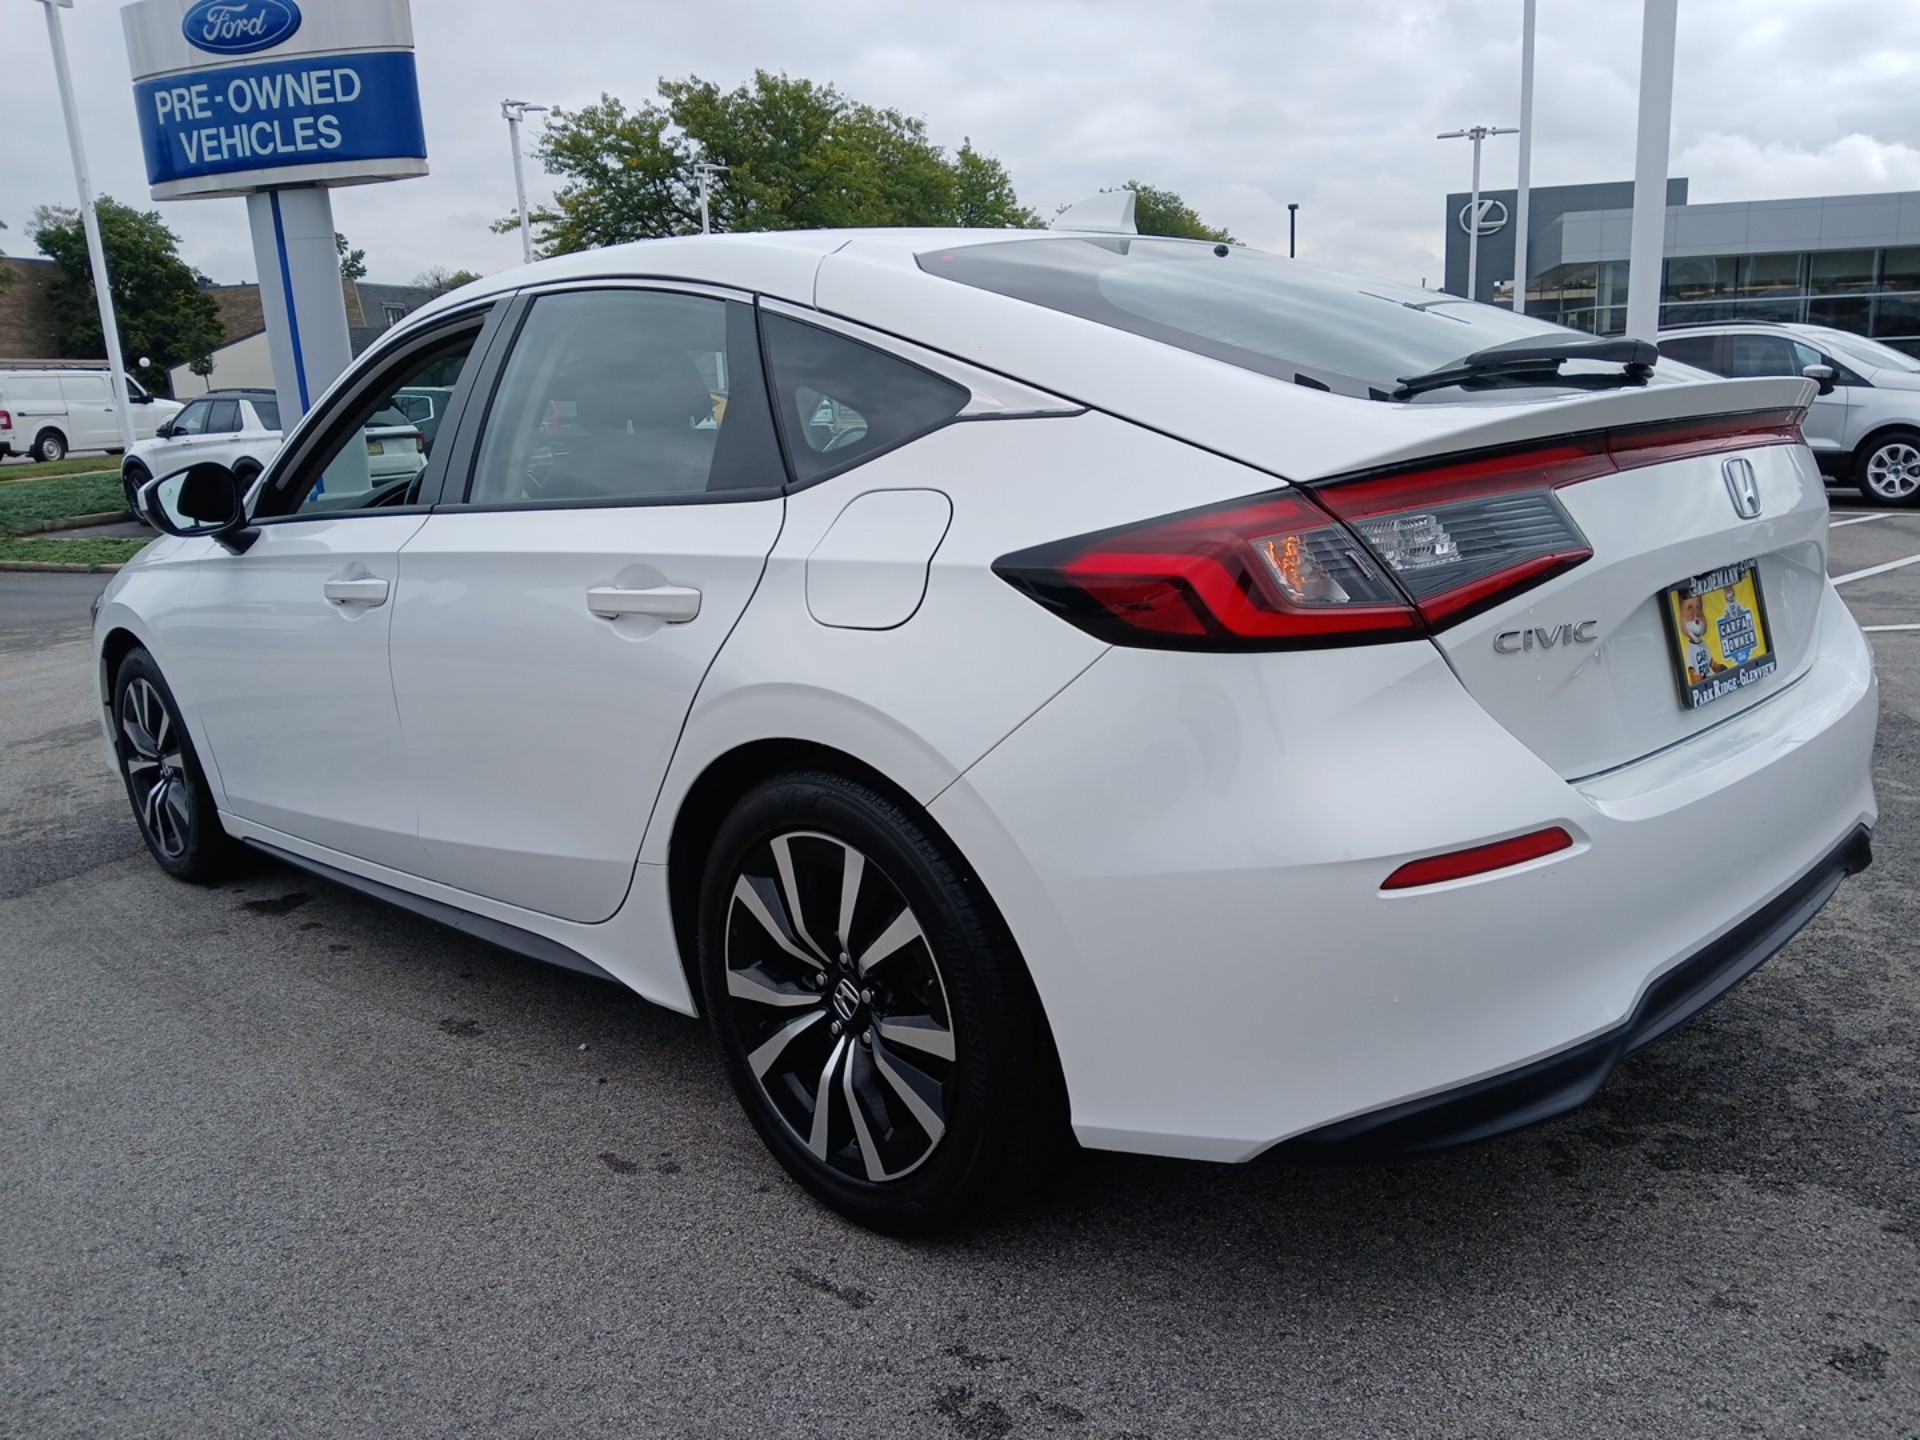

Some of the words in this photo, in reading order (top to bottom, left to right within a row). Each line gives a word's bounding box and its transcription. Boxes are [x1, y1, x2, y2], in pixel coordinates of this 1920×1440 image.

[203, 3, 267, 41] Ford
[155, 67, 361, 125] PRE-OWNED
[179, 114, 342, 164] VEHICLES
[1493, 619, 1598, 654] CIVIC
